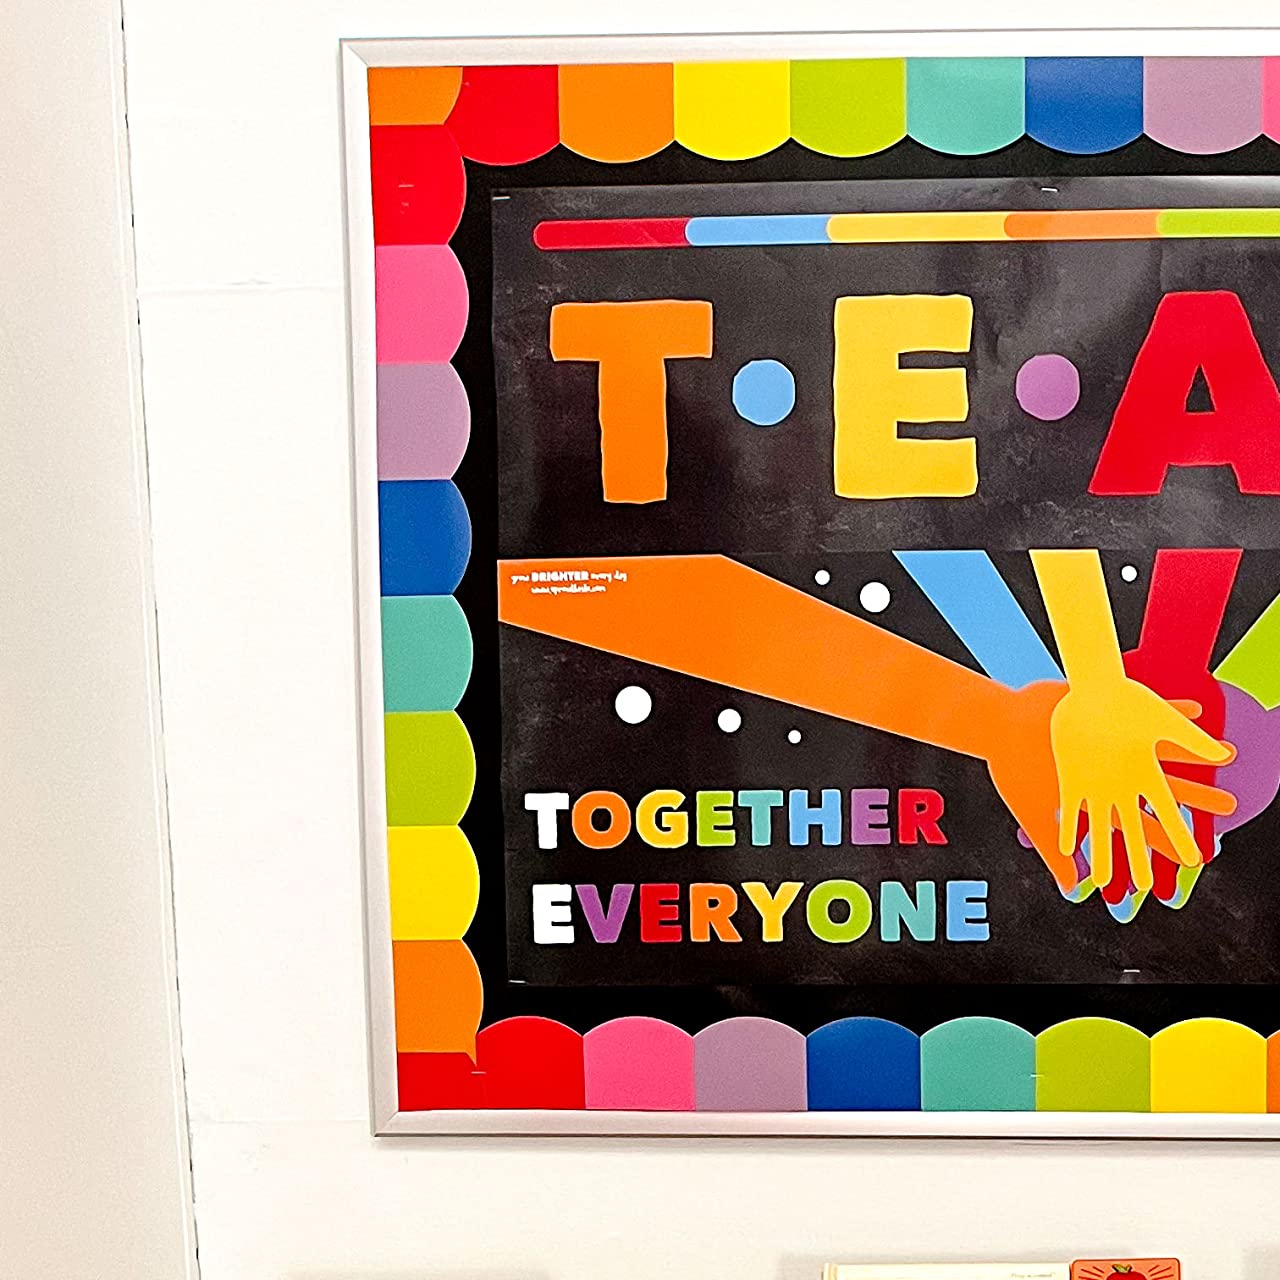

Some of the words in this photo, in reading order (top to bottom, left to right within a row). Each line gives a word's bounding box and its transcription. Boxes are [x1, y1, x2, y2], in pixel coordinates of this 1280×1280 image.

[531, 571, 589, 582] BRIGHTER
[524, 788, 948, 850] TOGETHER
[532, 879, 991, 945] EVERYONE
